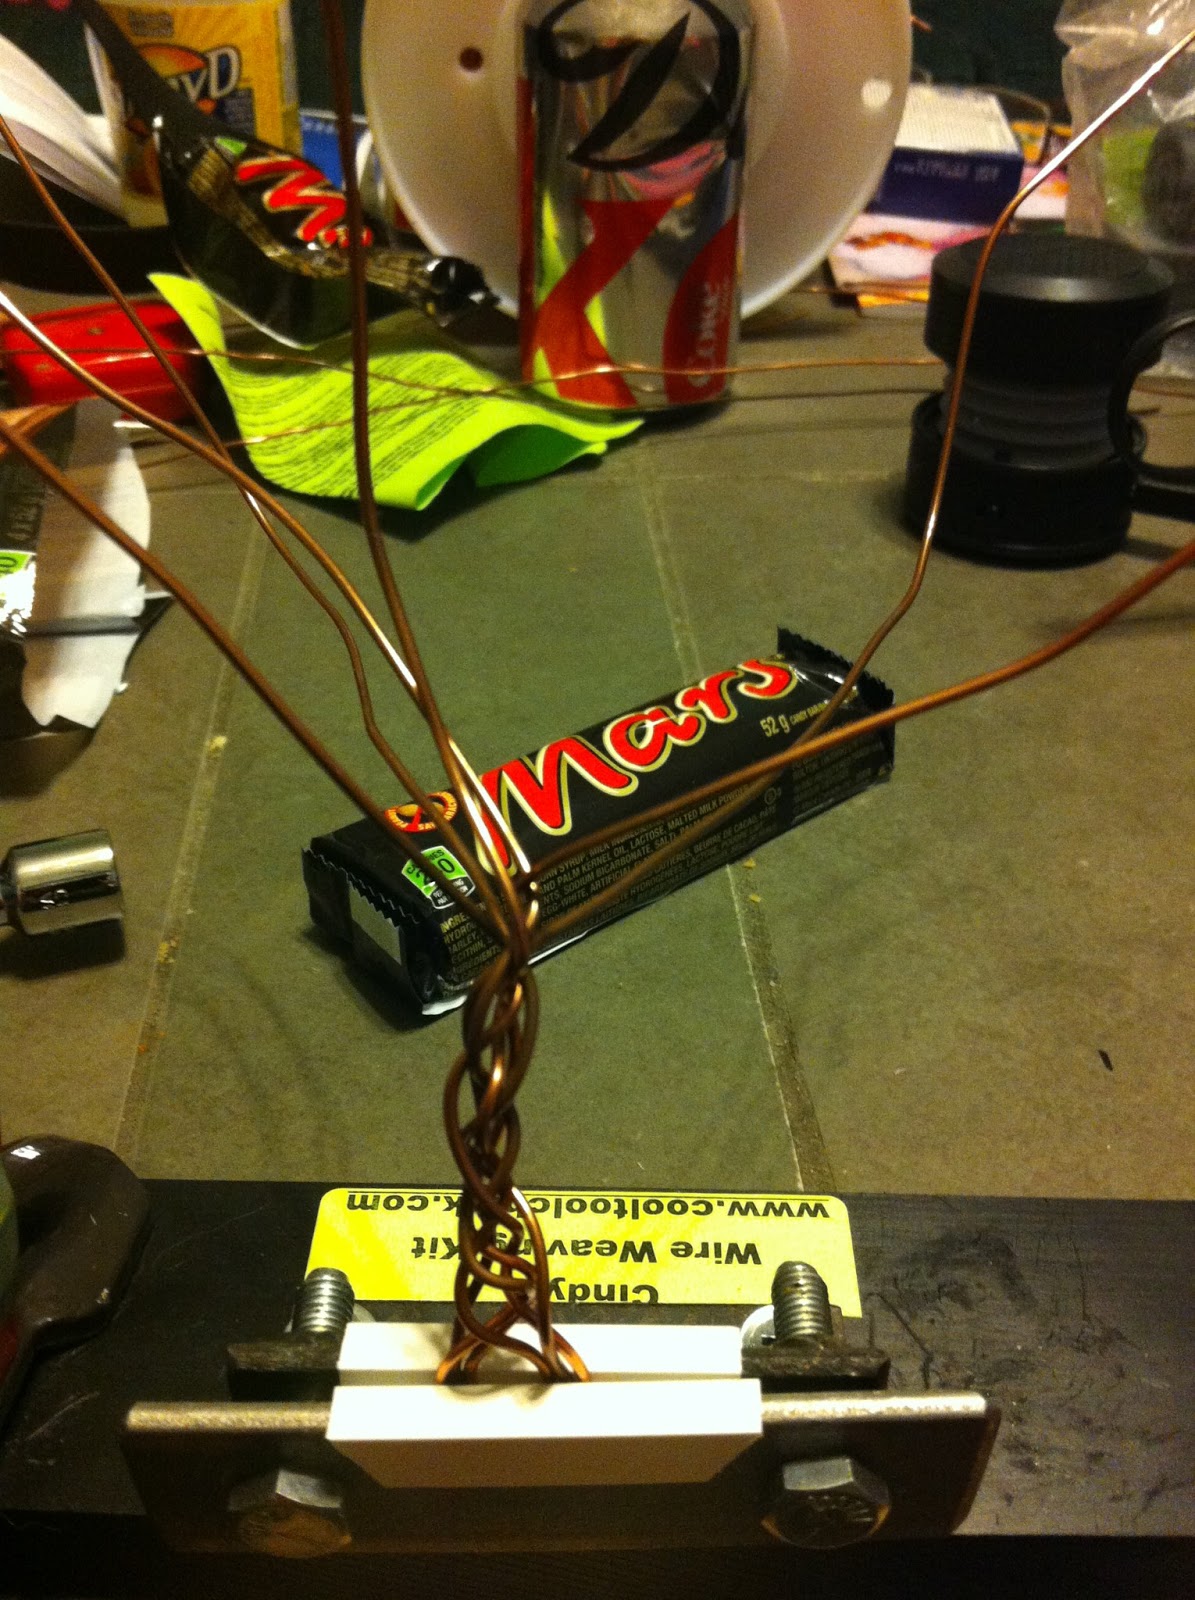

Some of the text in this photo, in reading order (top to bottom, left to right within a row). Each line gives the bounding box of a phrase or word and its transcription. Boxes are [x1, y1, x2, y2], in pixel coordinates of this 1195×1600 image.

[760, 715, 780, 737] 52
[474, 658, 798, 876] Mars
[668, 808, 696, 830] MALTED
[699, 798, 717, 815] MILK
[346, 1193, 831, 1218] www.cooltoolchk.com
[411, 1236, 462, 1261] Kit
[671, 1239, 763, 1266] Wire
